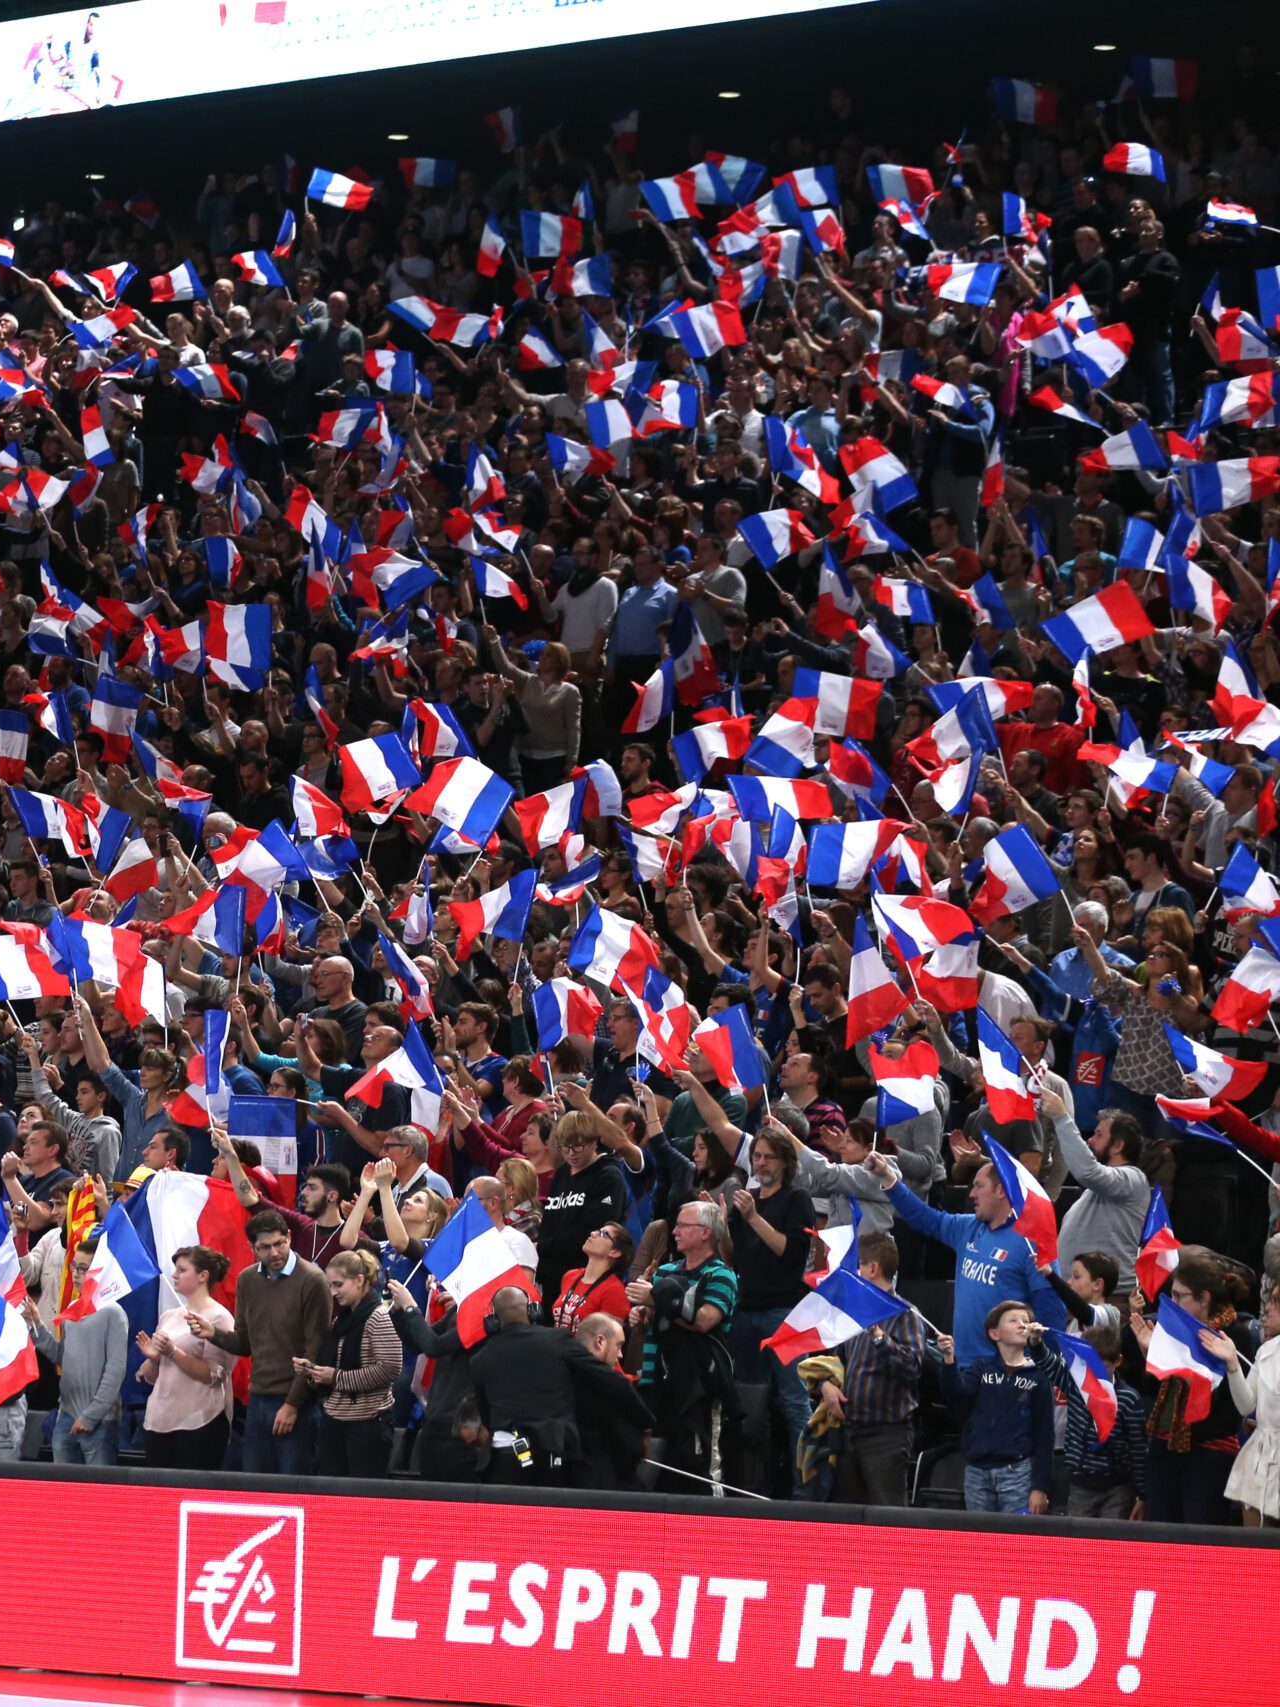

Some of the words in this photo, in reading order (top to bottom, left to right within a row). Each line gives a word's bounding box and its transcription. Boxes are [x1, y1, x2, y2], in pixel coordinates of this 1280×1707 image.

[545, 1191, 586, 1210] adidas
[961, 1256, 998, 1286] FRANCE
[981, 1373, 1004, 1385] NEW
[1014, 1376, 1038, 1391] YORK
[373, 1556, 768, 1662] L'ESPRIT
